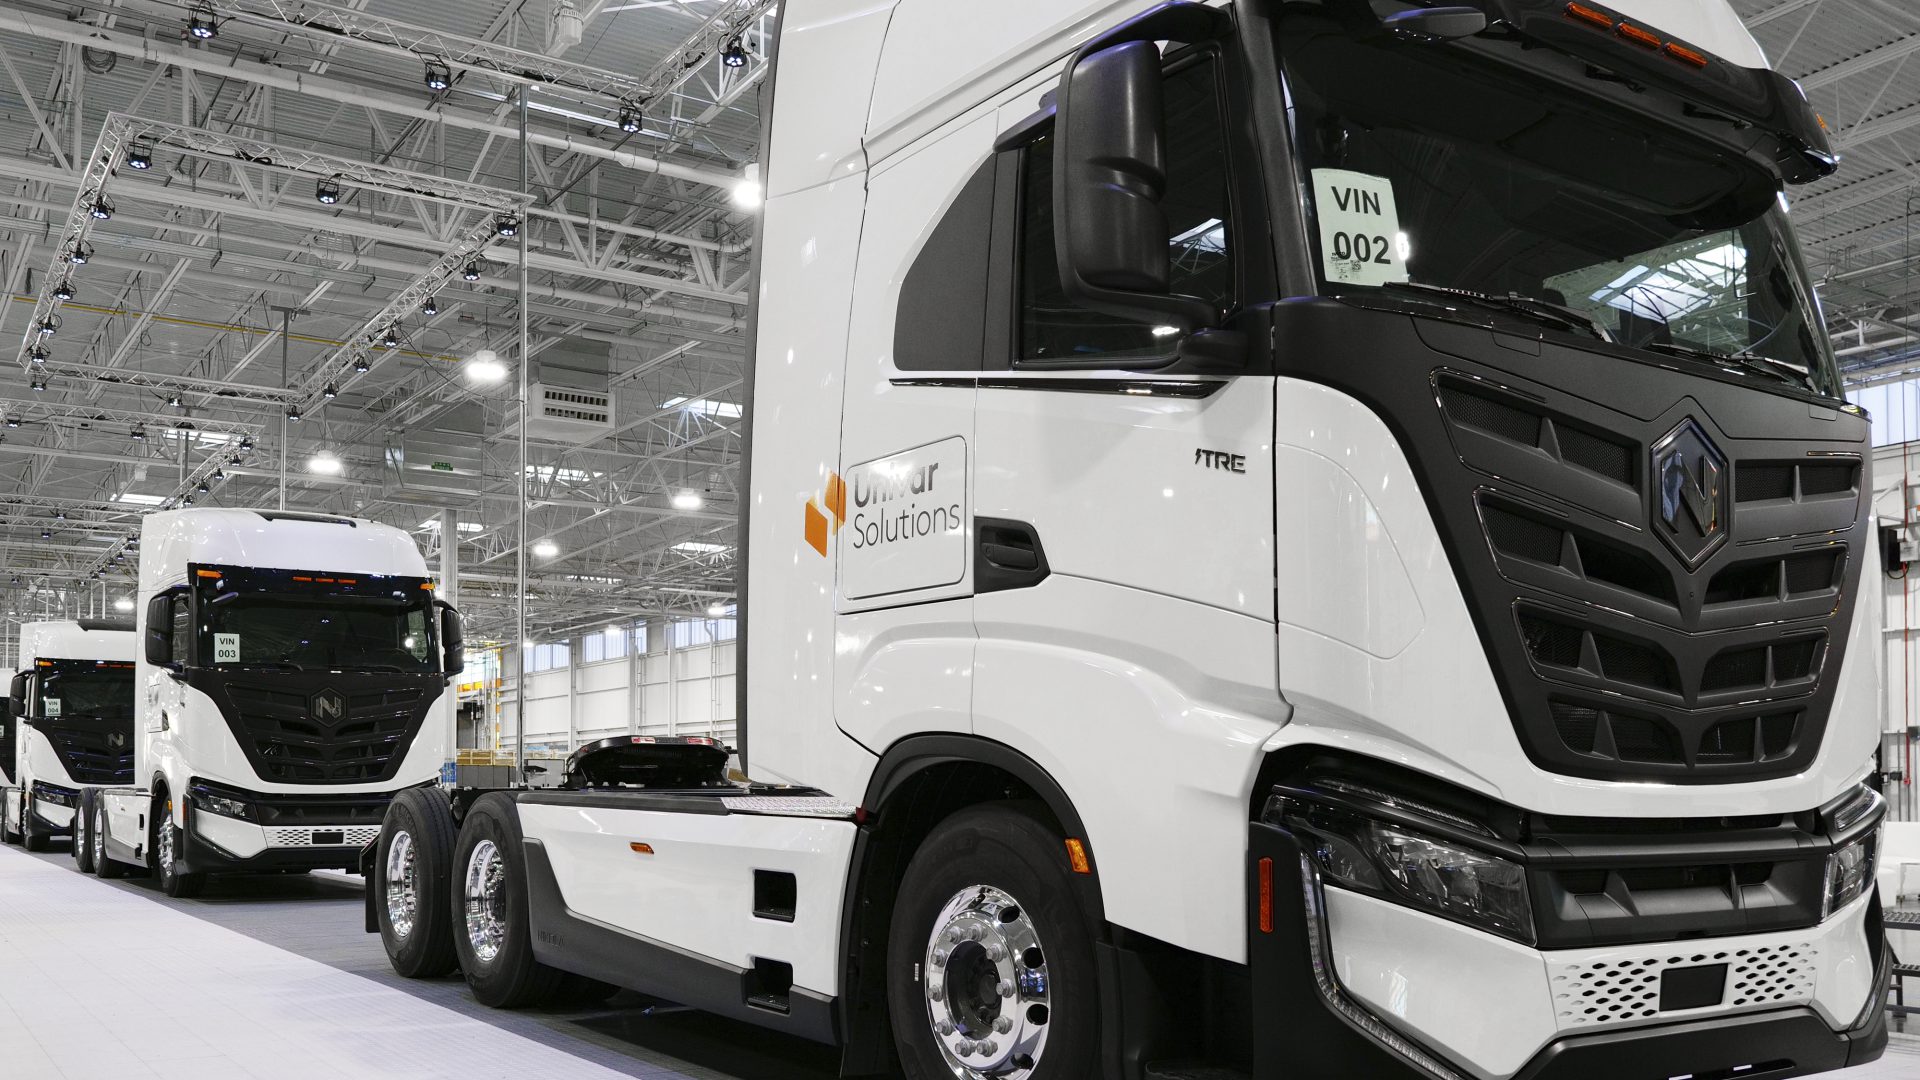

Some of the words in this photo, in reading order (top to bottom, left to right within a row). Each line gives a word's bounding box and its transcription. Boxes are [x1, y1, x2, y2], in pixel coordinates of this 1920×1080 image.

[1331, 186, 1381, 216] VIN
[1333, 231, 1391, 265] 002
[853, 503, 960, 549] Solutions
[218, 649, 236, 658] 003
[219, 637, 235, 645] VIN
